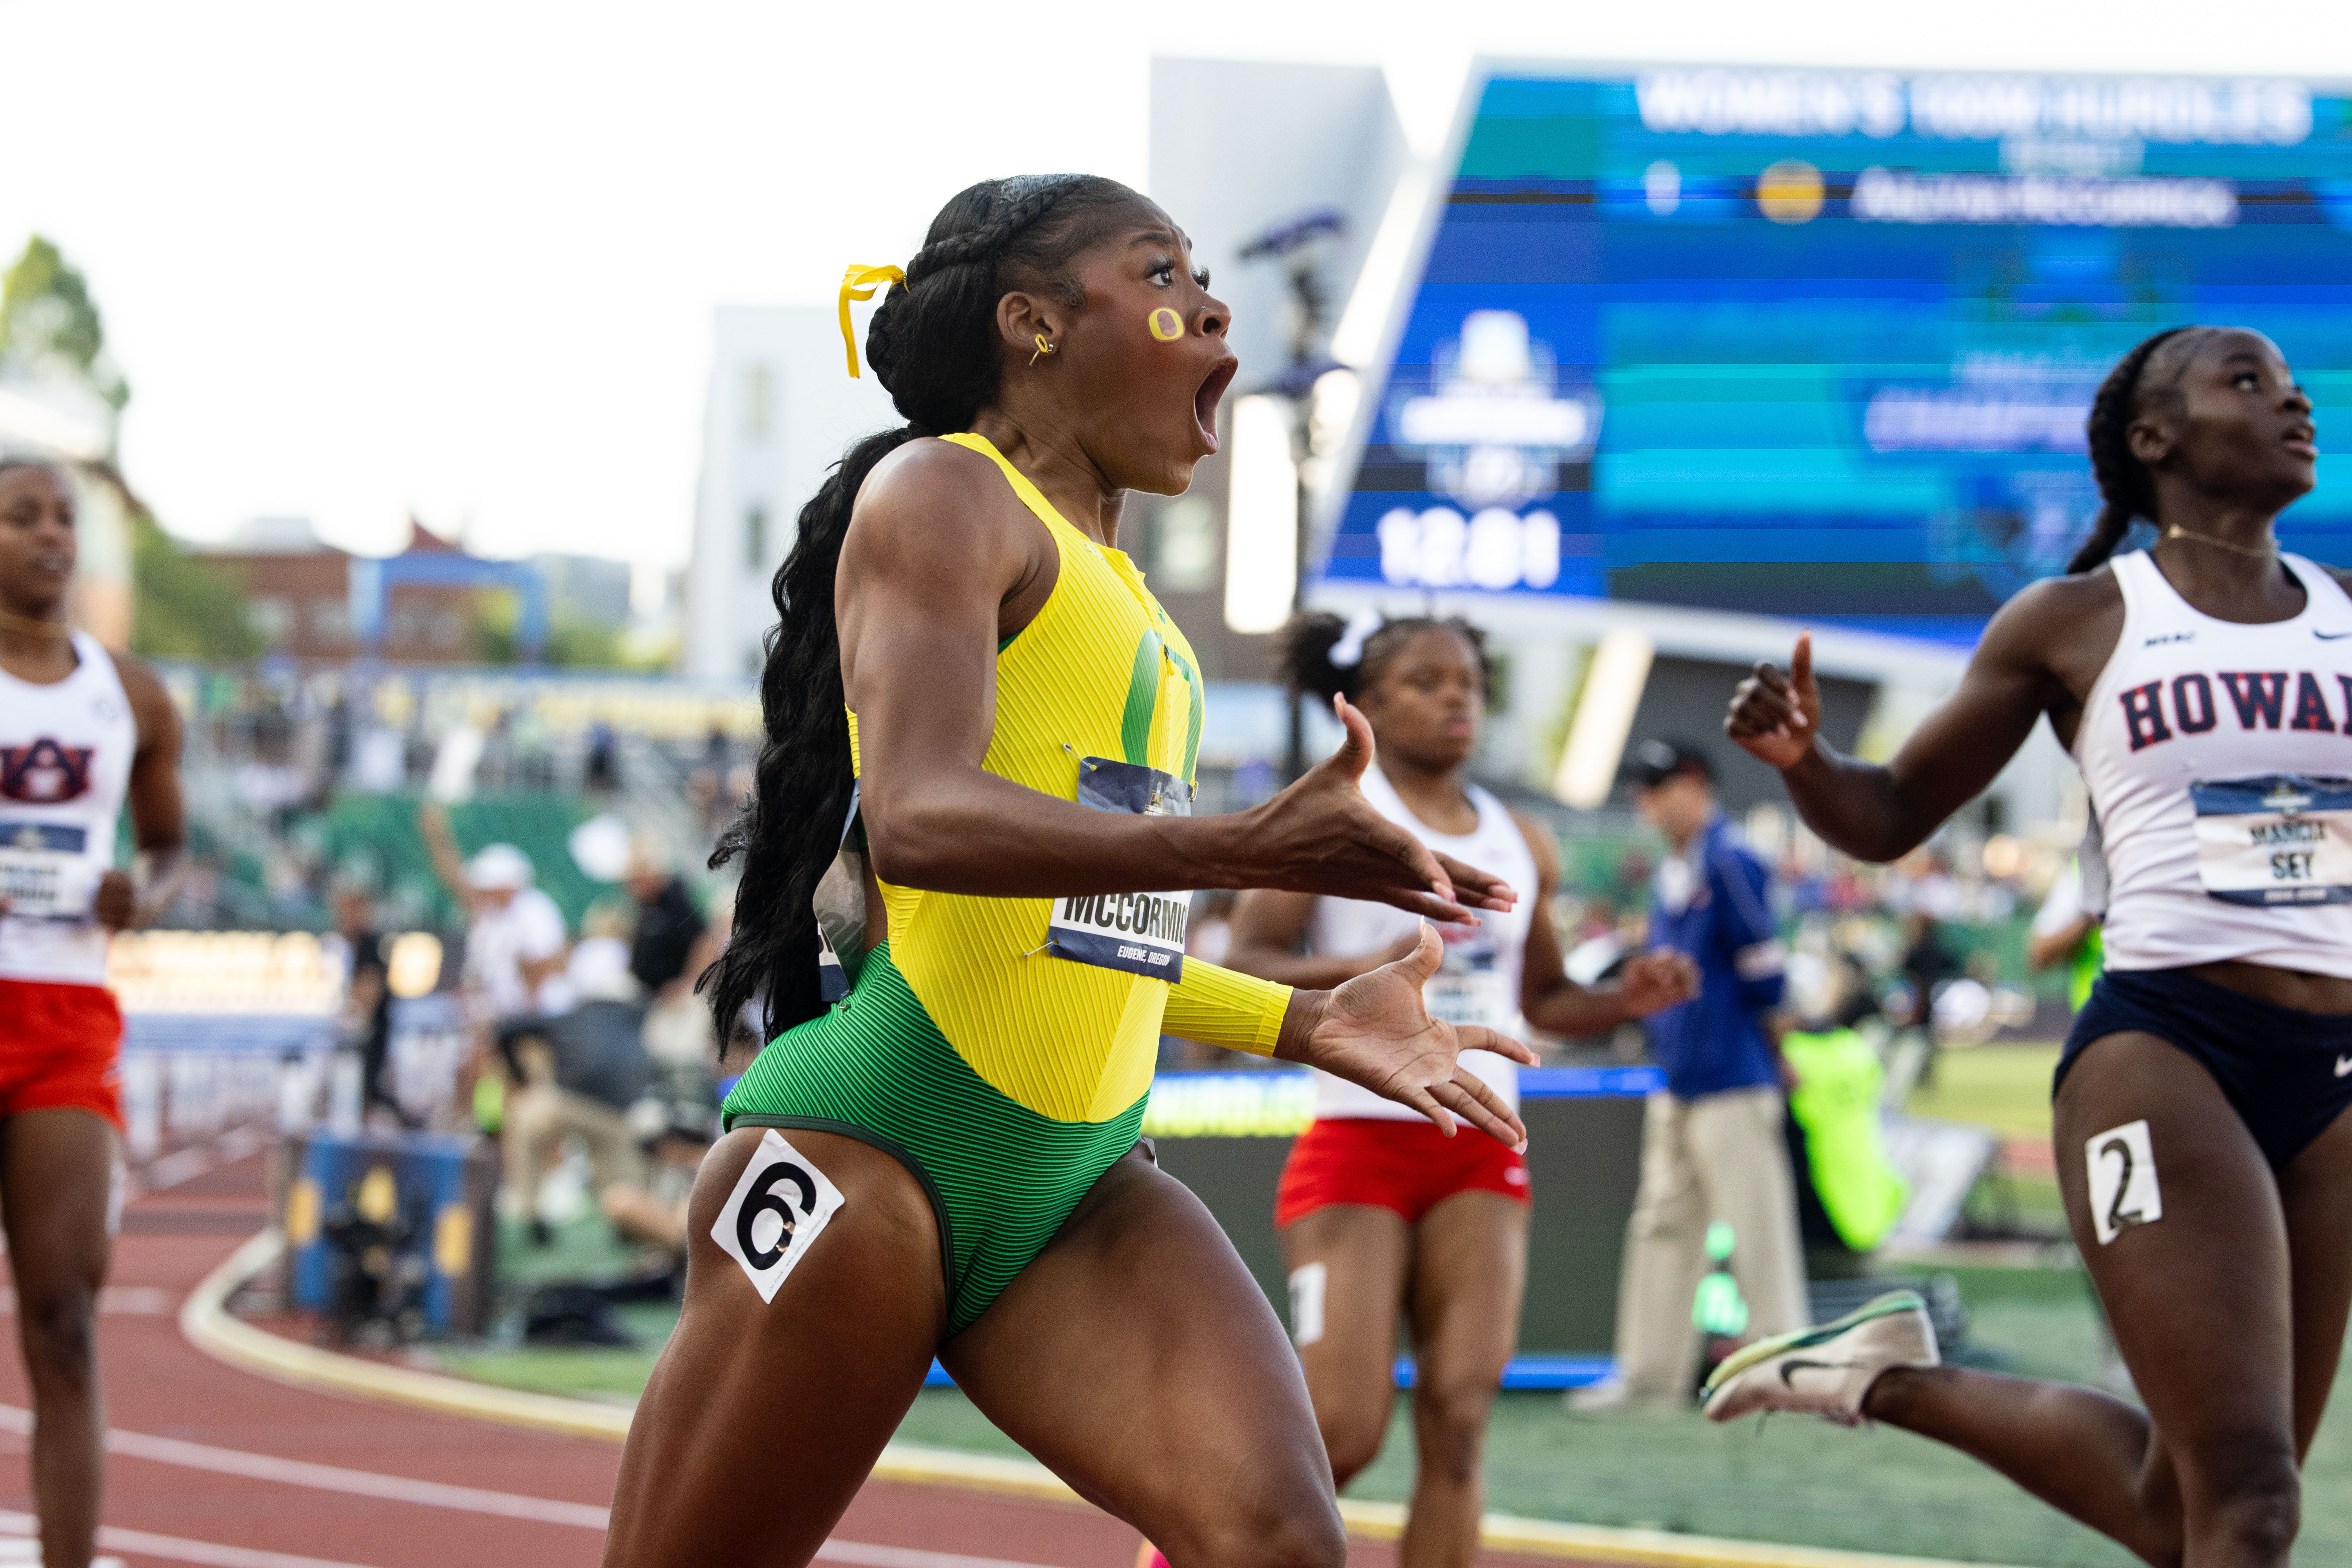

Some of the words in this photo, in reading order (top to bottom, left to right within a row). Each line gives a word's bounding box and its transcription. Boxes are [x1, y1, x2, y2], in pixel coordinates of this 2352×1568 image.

[1635, 74, 1904, 137] WOMEN'S
[2045, 79, 2314, 147] HURDLES
[2272, 852, 2312, 880] SEY
[1063, 893, 1188, 945] MCCORMIC
[1117, 945, 1147, 963] EUGENE,
[1148, 952, 1170, 966] OREGON
[2100, 1138, 2143, 1230] 2
[737, 1161, 817, 1270] 6
[774, 1270, 784, 1283] Track
